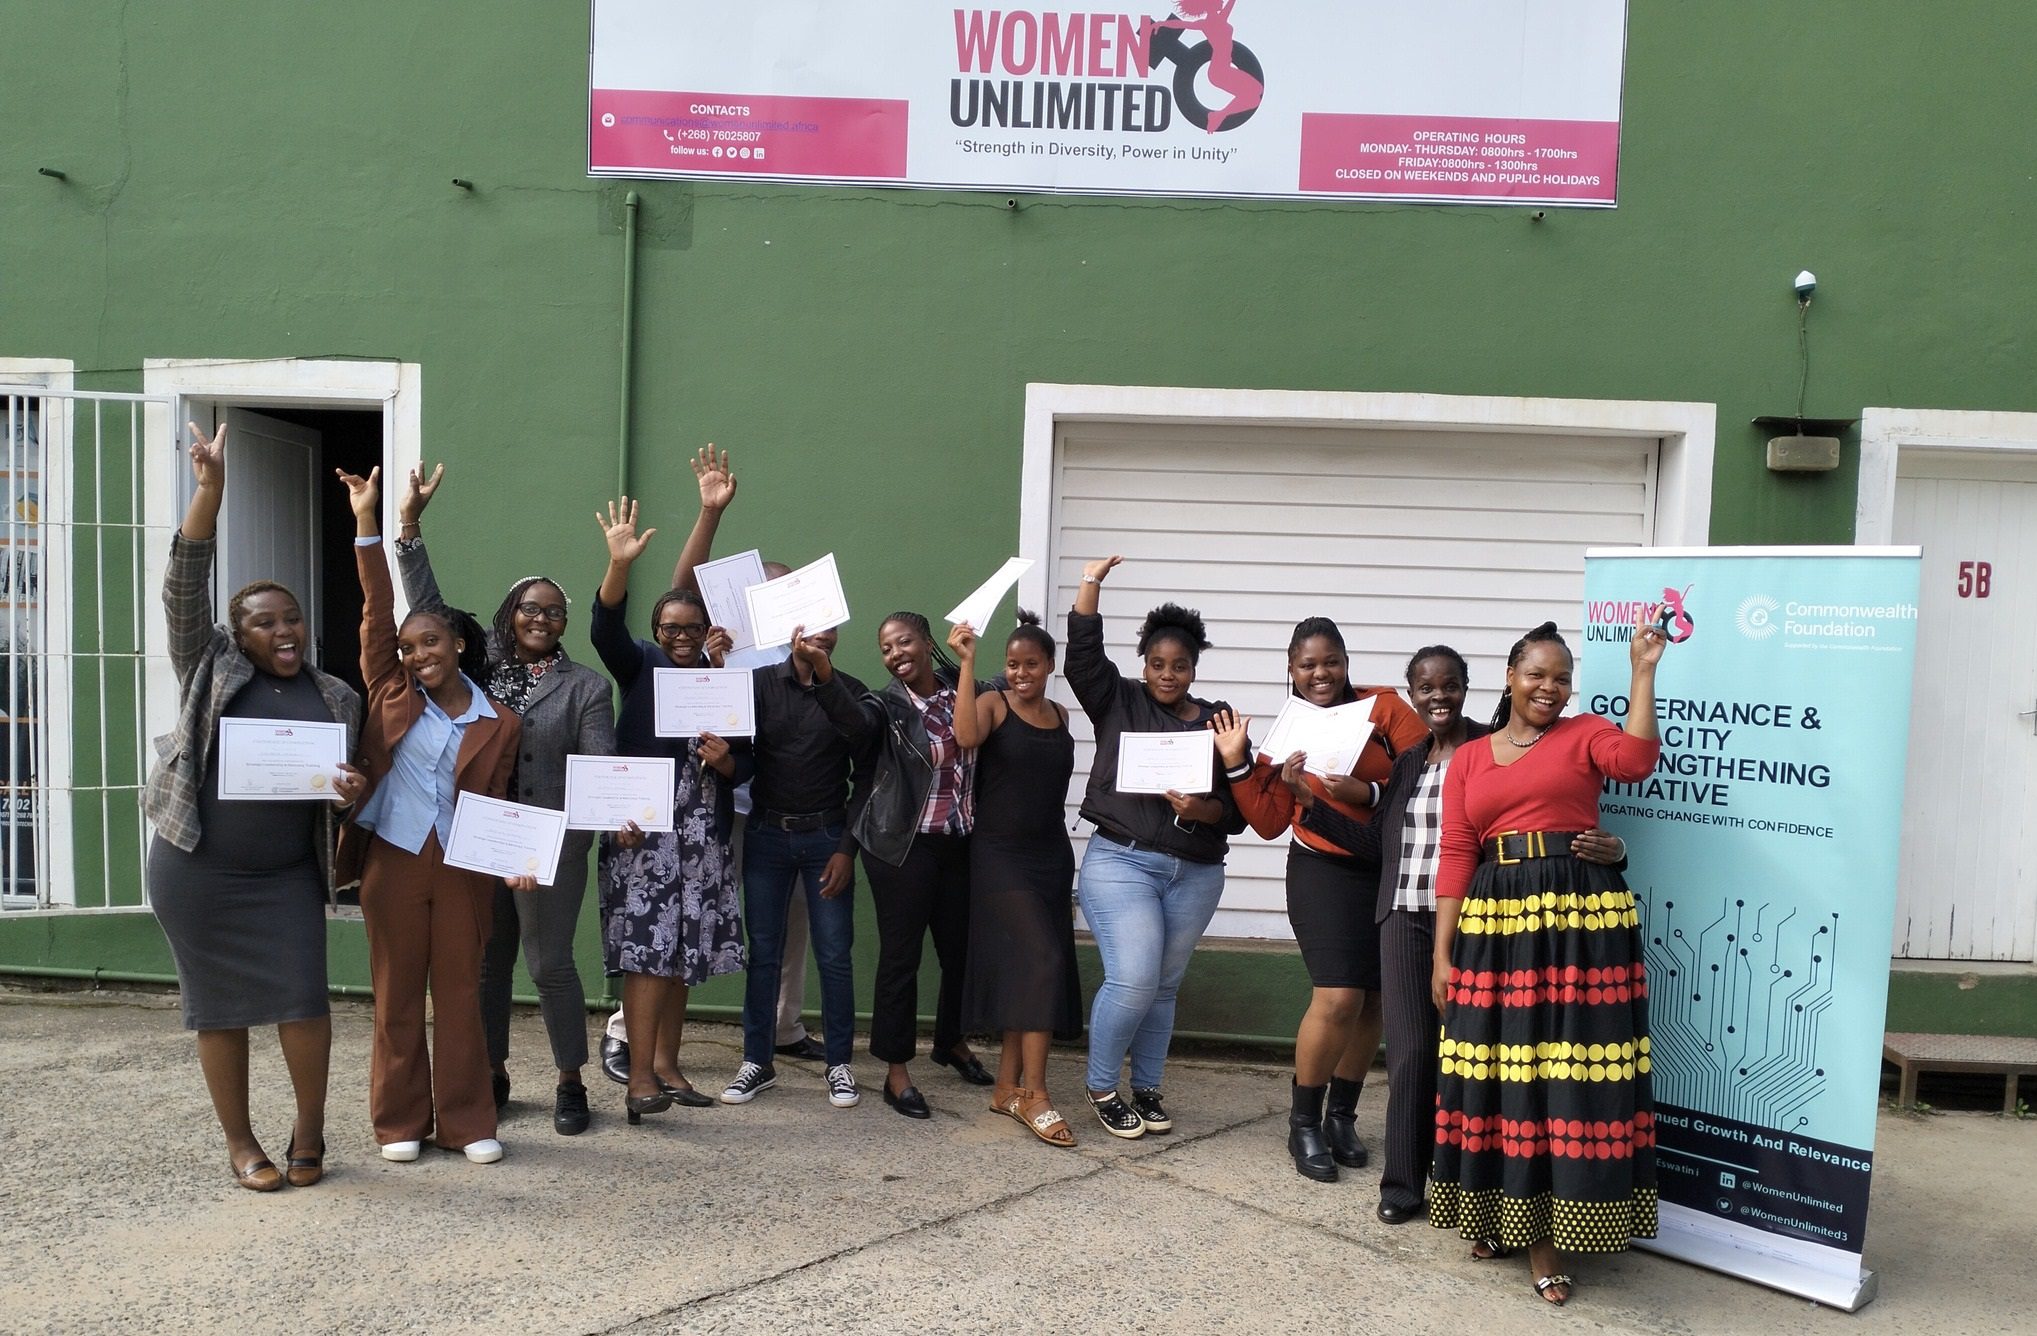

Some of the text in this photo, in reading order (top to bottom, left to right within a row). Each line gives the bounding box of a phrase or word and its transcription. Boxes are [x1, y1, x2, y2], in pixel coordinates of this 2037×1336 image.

[953, 9, 1152, 78] WOMEN
[690, 104, 750, 116] CONTACTS
[949, 78, 1172, 132] UNLIMITED
[677, 129, 761, 142] (+268) 76025807
[1413, 131, 1526, 144] OPERATING HOURS
[671, 145, 709, 155] follow us:
[1030, 141, 1043, 154] in
[1049, 142, 1117, 160] Diversity,
[1122, 145, 1168, 159] Power
[1173, 146, 1186, 159] in
[1360, 143, 1411, 154] MONDAY-
[1414, 144, 1478, 156] THURSDAY:
[1481, 146, 1525, 157] 0800hrs
[1534, 148, 1578, 159] 1700hrs
[1398, 157, 1485, 169] FRIDAY:0800hrs
[1494, 160, 1538, 171] 1300hrs
[1335, 169, 1600, 186] CLOSED ON WEEKENDS AND PUPLIC HOLIDAYS
[1957, 561, 1992, 598] 5B
[1785, 601, 1918, 619] Commonwealth
[1587, 625, 1636, 643] UNLIMI
[1784, 621, 1876, 638] Foundation
[1590, 694, 1822, 730] GOERNANCE &
[1599, 803, 1654, 818] VIGATING
[1656, 809, 1710, 825] CHANGE
[1711, 816, 1744, 828] WITH
[1693, 1119, 1748, 1143] Growth
[1753, 1134, 1783, 1151] And
[1788, 1142, 1871, 1172] Relevance
